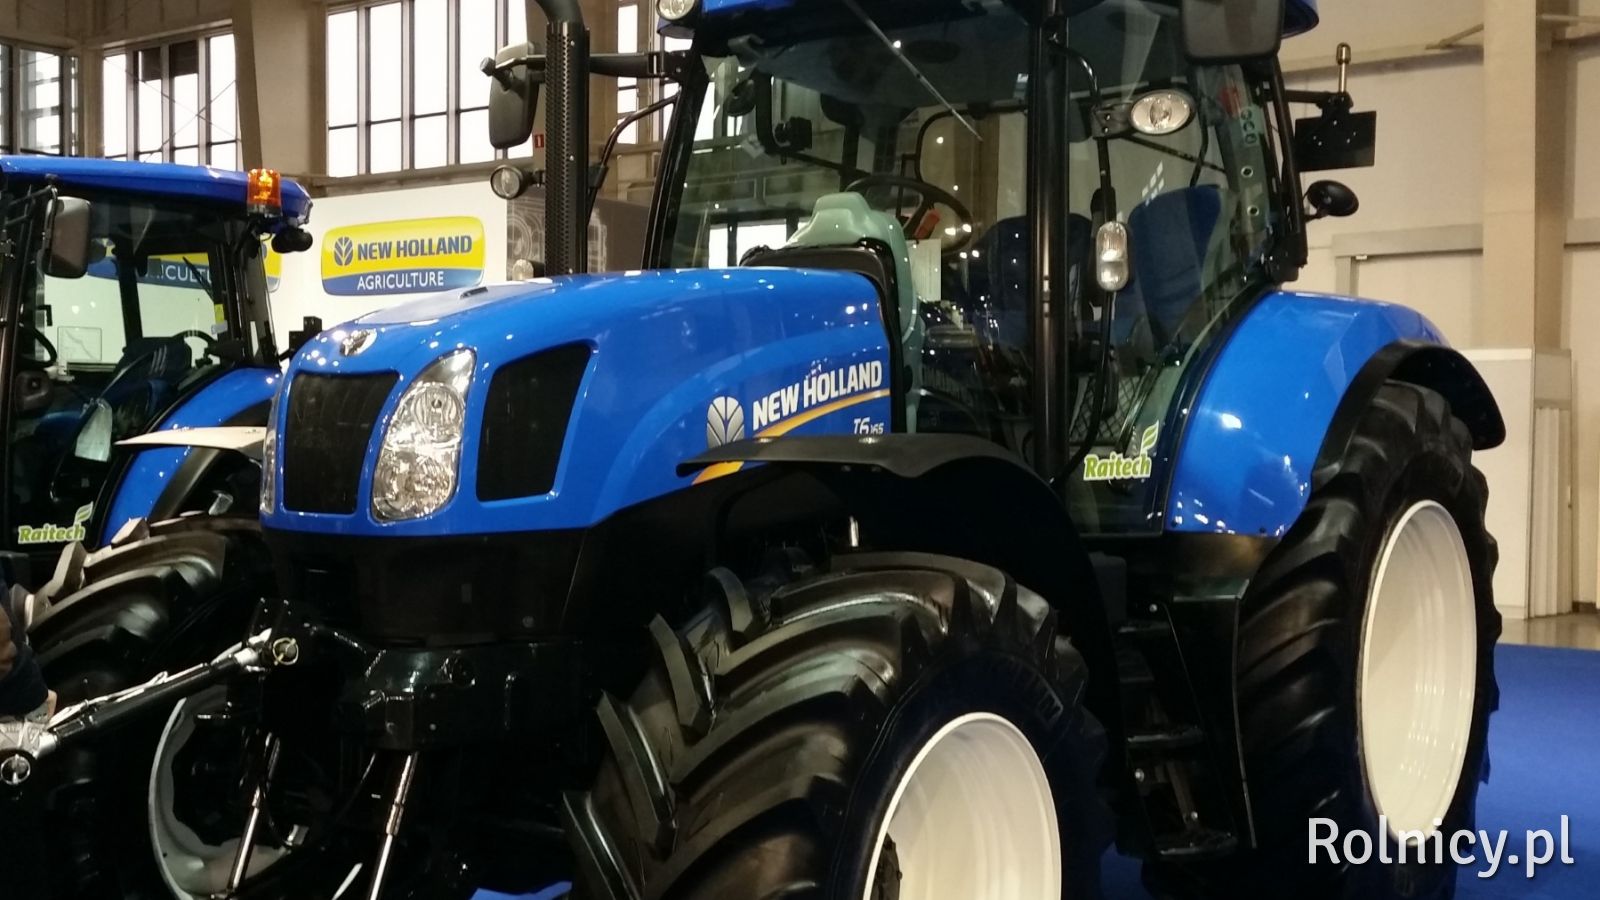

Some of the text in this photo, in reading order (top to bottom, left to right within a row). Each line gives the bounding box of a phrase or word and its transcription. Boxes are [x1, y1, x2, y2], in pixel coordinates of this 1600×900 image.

[357, 235, 472, 260] NEW HOLLAND
[357, 271, 444, 290] AGRICULTURE
[752, 360, 882, 431] NEW HOLLAND
[1083, 451, 1152, 480] Raitech
[18, 523, 86, 544] Raitech
